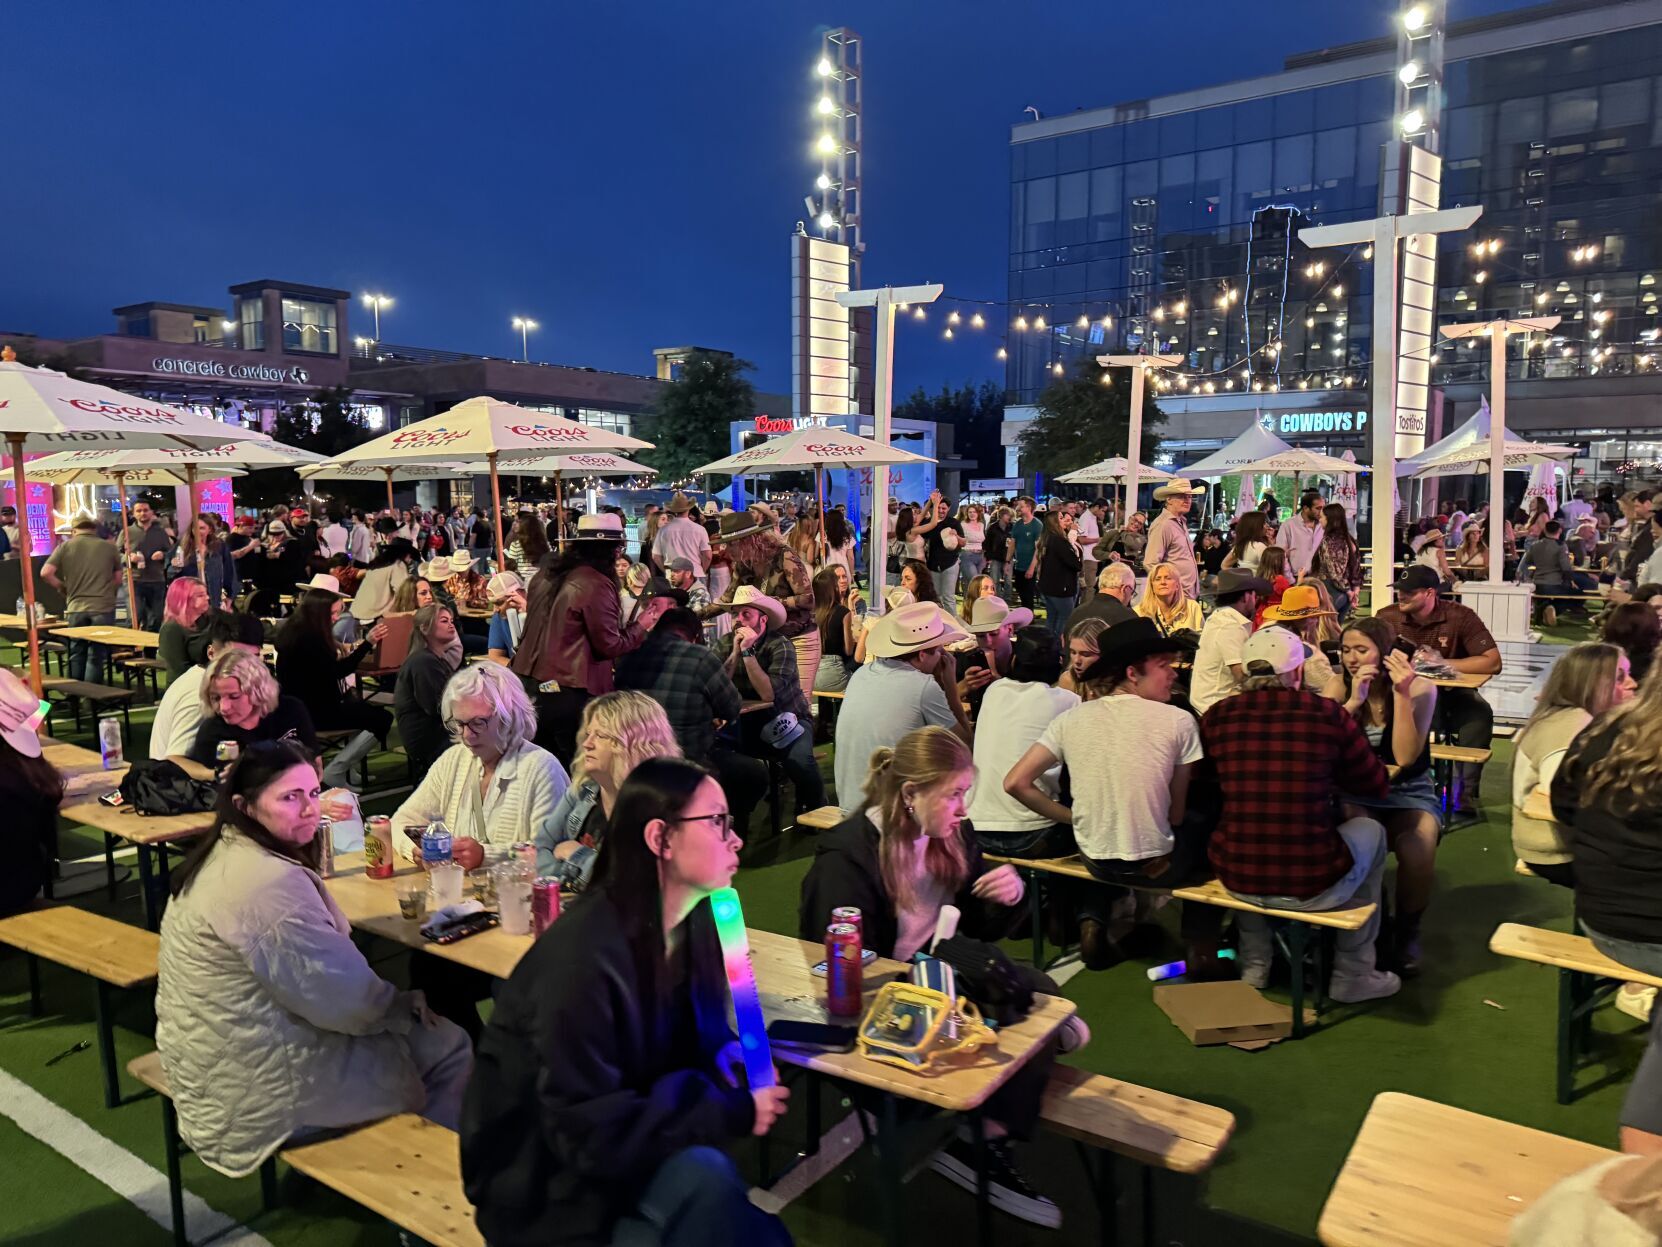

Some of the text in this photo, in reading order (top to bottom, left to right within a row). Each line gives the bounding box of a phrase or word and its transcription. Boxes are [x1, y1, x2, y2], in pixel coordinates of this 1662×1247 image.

[152, 358, 287, 382] concrete cowboy
[58, 398, 176, 417] Coors
[101, 412, 185, 425] LIGHT
[755, 414, 794, 433] Coors
[1280, 411, 1353, 433] COWBOYS
[392, 429, 472, 443] Coors
[504, 425, 588, 436] Coors
[389, 439, 457, 450] LIGHT
[803, 444, 867, 453] Coors
